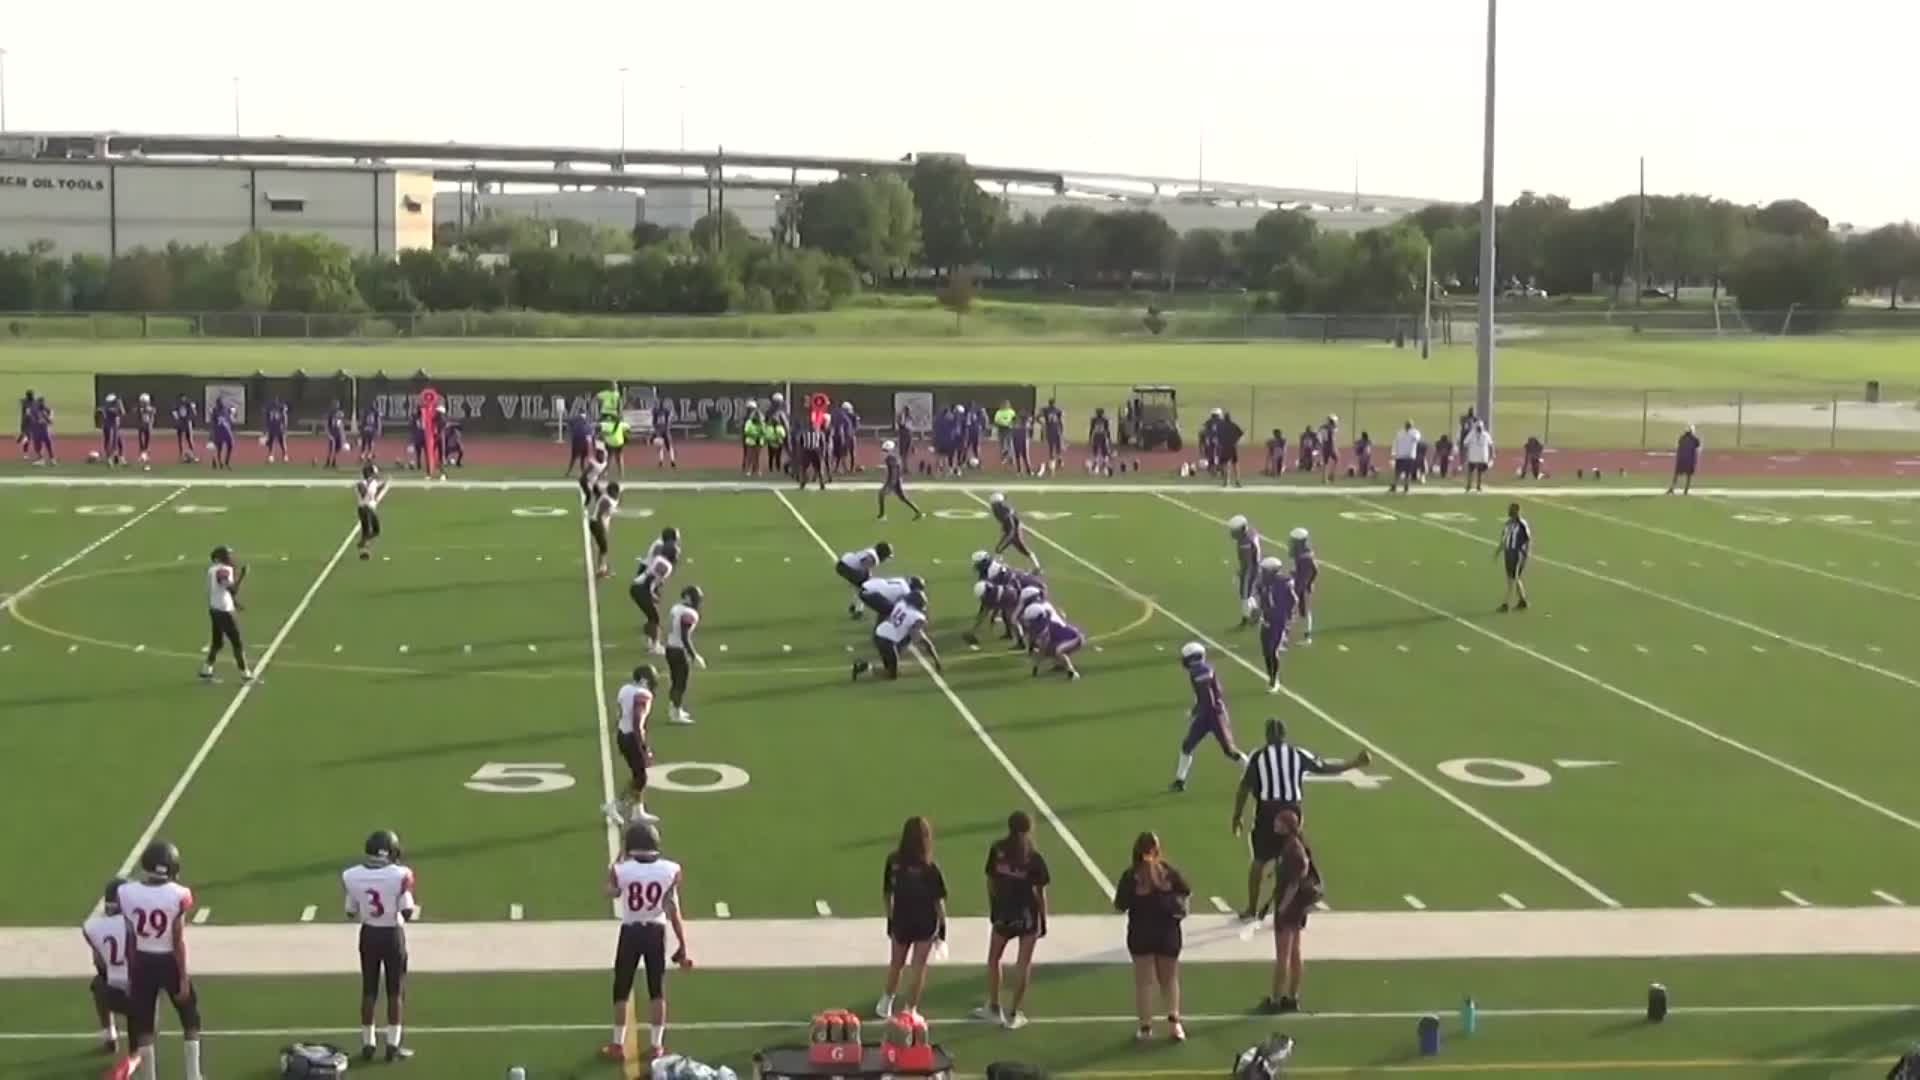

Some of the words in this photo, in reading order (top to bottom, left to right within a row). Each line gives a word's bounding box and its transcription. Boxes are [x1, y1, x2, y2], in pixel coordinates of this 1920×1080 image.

[57, 179, 104, 191] TOOLS
[365, 887, 385, 918] 3
[628, 881, 662, 912] 89
[132, 907, 168, 938] 29
